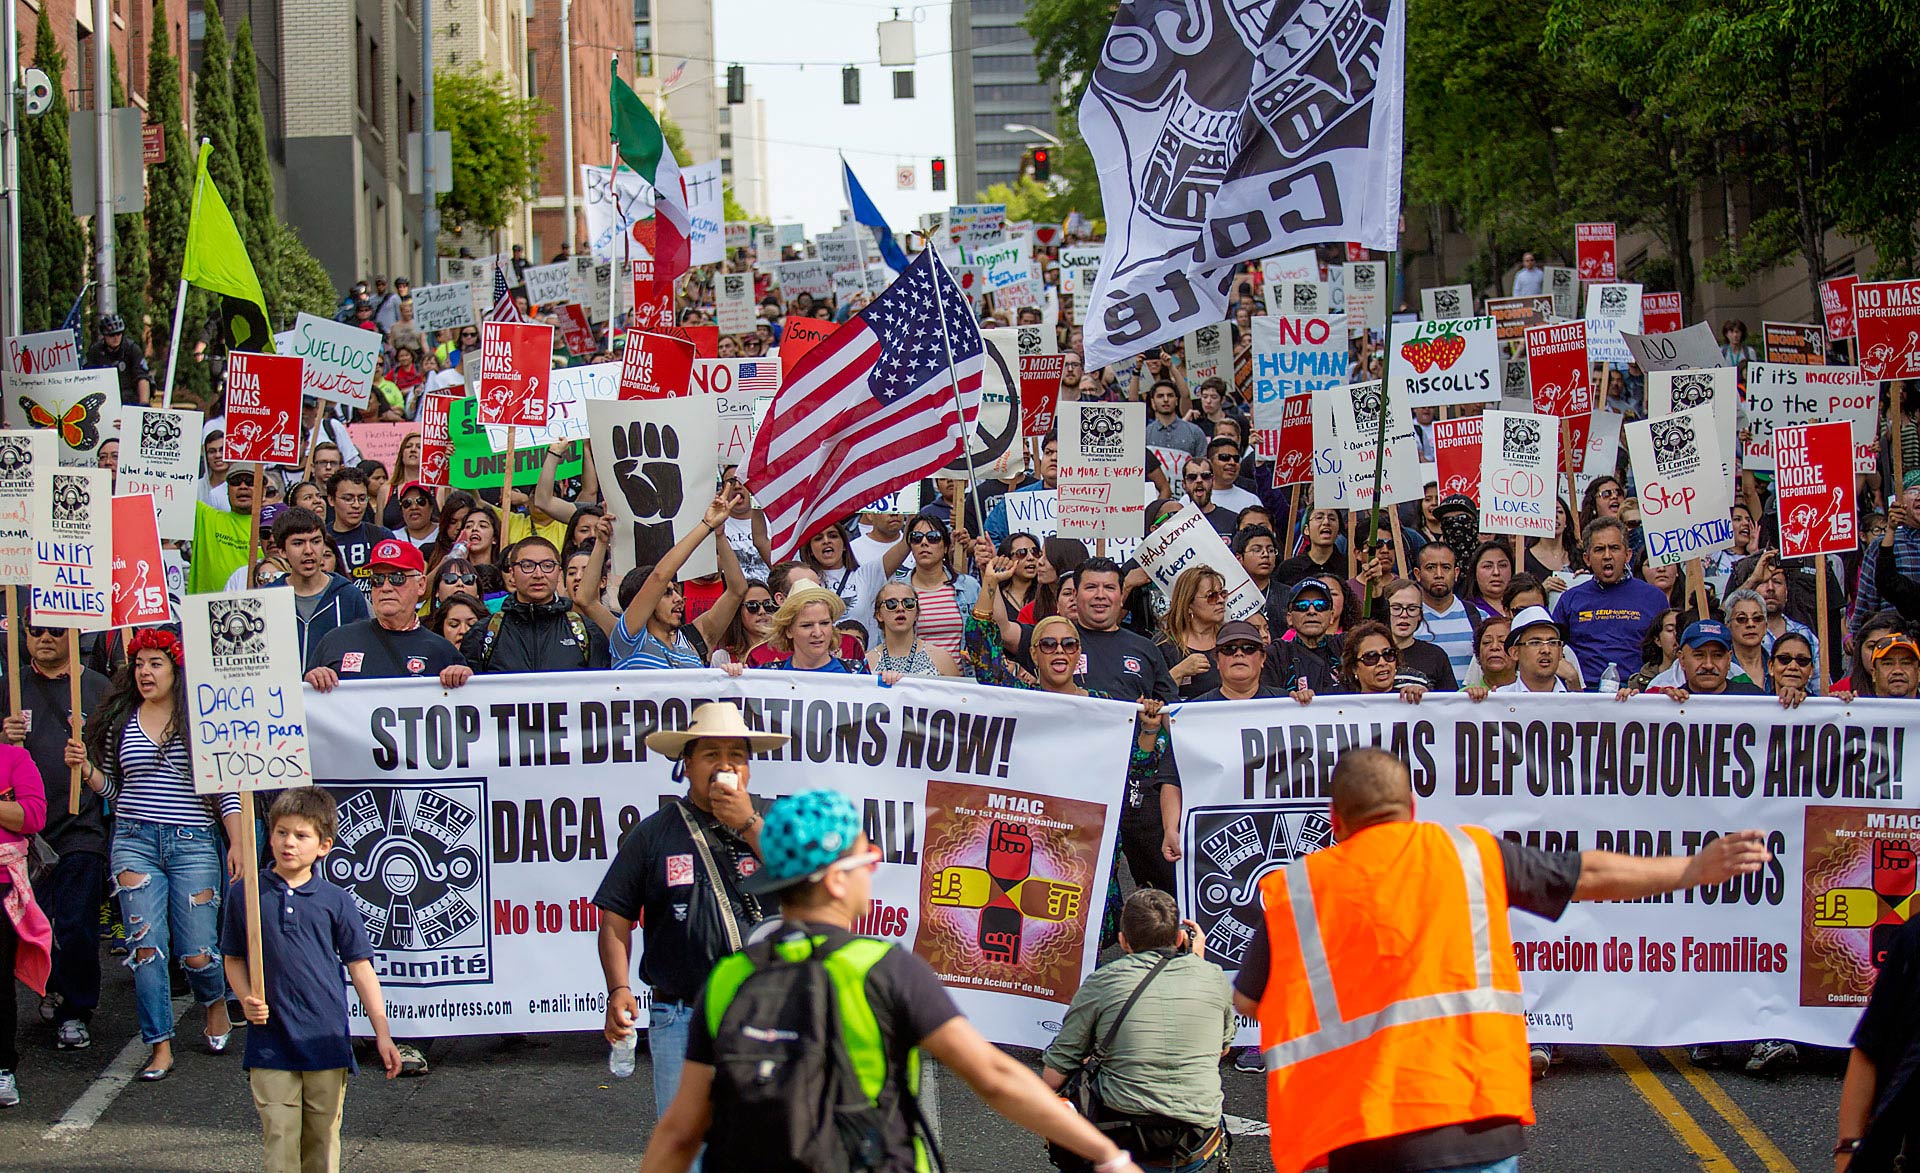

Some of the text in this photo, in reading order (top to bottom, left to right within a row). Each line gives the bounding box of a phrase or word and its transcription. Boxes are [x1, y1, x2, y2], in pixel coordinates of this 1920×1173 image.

[1578, 226, 1589, 236] NO
[1601, 263, 1614, 273] 15
[1643, 293, 1679, 309] NO MÁS
[1857, 290, 1881, 308] NO
[660, 311, 673, 322] 15
[1858, 306, 1920, 318] DEPORTACIONE
[485, 325, 500, 341] NI
[1278, 316, 1330, 346] NO
[1529, 325, 1584, 347] NO MORE
[485, 341, 512, 357] UNA
[630, 333, 645, 350] NI
[1531, 341, 1585, 357] DEPORTATIONS
[1639, 337, 1678, 360] NO
[232, 356, 248, 373] NI
[483, 356, 512, 372] MAS
[627, 350, 653, 366] UNA
[1030, 357, 1062, 371] MORE
[1259, 351, 1348, 377] HUMAN
[231, 373, 261, 390] UNA
[483, 369, 522, 381] DEPORTACIÓN
[624, 365, 652, 383] MAS
[1020, 368, 1061, 380] PORTATIONS
[1750, 366, 1798, 385] if it's
[622, 380, 661, 394] DEPORTACIÓN
[1570, 387, 1588, 404] 15
[230, 389, 261, 407] MAS
[426, 397, 439, 411] NI
[716, 397, 754, 414] Bein
[1571, 402, 1588, 411] NOW
[1747, 394, 1876, 413] to the poor
[229, 405, 271, 416] DEPORTACIÓN
[522, 399, 545, 416] 15
[1285, 402, 1305, 416] NO
[425, 410, 448, 426] UNA
[1034, 412, 1051, 426] 15
[1283, 416, 1313, 428] DEPORTA
[424, 425, 448, 440] MAS
[1436, 423, 1454, 436] NO
[271, 433, 295, 451] 15
[1437, 435, 1483, 448] DEPORTATIO
[1777, 428, 1808, 449] NOT
[140, 449, 181, 458] El Comité
[270, 450, 294, 458] AHORA
[1080, 445, 1125, 454] El Comité
[1357, 447, 1393, 462] DAA
[1511, 452, 1541, 461] Comité
[1779, 447, 1810, 468] ONE
[119, 464, 141, 476] What
[144, 466, 154, 476] do
[1060, 465, 1144, 478] NO MORE E-VERIFY
[1657, 455, 1701, 472] El Comité
[1491, 468, 1544, 498] GOD
[1779, 464, 1824, 488] MORE
[128, 480, 174, 501] DAPA
[1060, 486, 1105, 499] E-VERIFY
[1642, 482, 1696, 516] Stop
[1780, 484, 1827, 498] DEPORTATION
[1058, 504, 1101, 515] DESTROYS
[1104, 504, 1119, 514] THE
[1494, 496, 1540, 514] LOVES
[52, 519, 92, 529] El Comité
[1485, 513, 1554, 532] IMMIGRANTS
[1828, 512, 1852, 535] 15
[1648, 518, 1734, 557] DEPORTING
[1829, 532, 1852, 541] AHORA
[37, 540, 95, 565] UNIFY
[1660, 553, 1681, 565] US
[1154, 545, 1197, 586] Fuera
[56, 566, 92, 586] ALL
[33, 587, 105, 613] FAMILIES
[134, 586, 163, 609] 15
[1226, 593, 1244, 609] para
[137, 607, 164, 616] AHORA
[212, 654, 270, 667] El Comité
[197, 683, 255, 717] DACA
[199, 720, 305, 746] DAPA para
[371, 697, 1017, 778] STOP THE DEPOATIONS NOW!
[212, 750, 304, 782] TODOS
[1455, 720, 1906, 799] DEPORTACIONES AHORA!
[987, 793, 1045, 815] M1AC
[955, 806, 1074, 831] May 1st Action Coalition
[491, 796, 609, 864] DACA
[1835, 829, 1857, 838] May
[494, 896, 599, 935] No to th
[1603, 936, 1789, 973] de las Familias
[373, 950, 487, 978] Comité
[935, 972, 1055, 997] oalicion de Accion de Mayo
[529, 993, 571, 1013] e-mail:
[1828, 993, 1868, 1003] Coalicion
